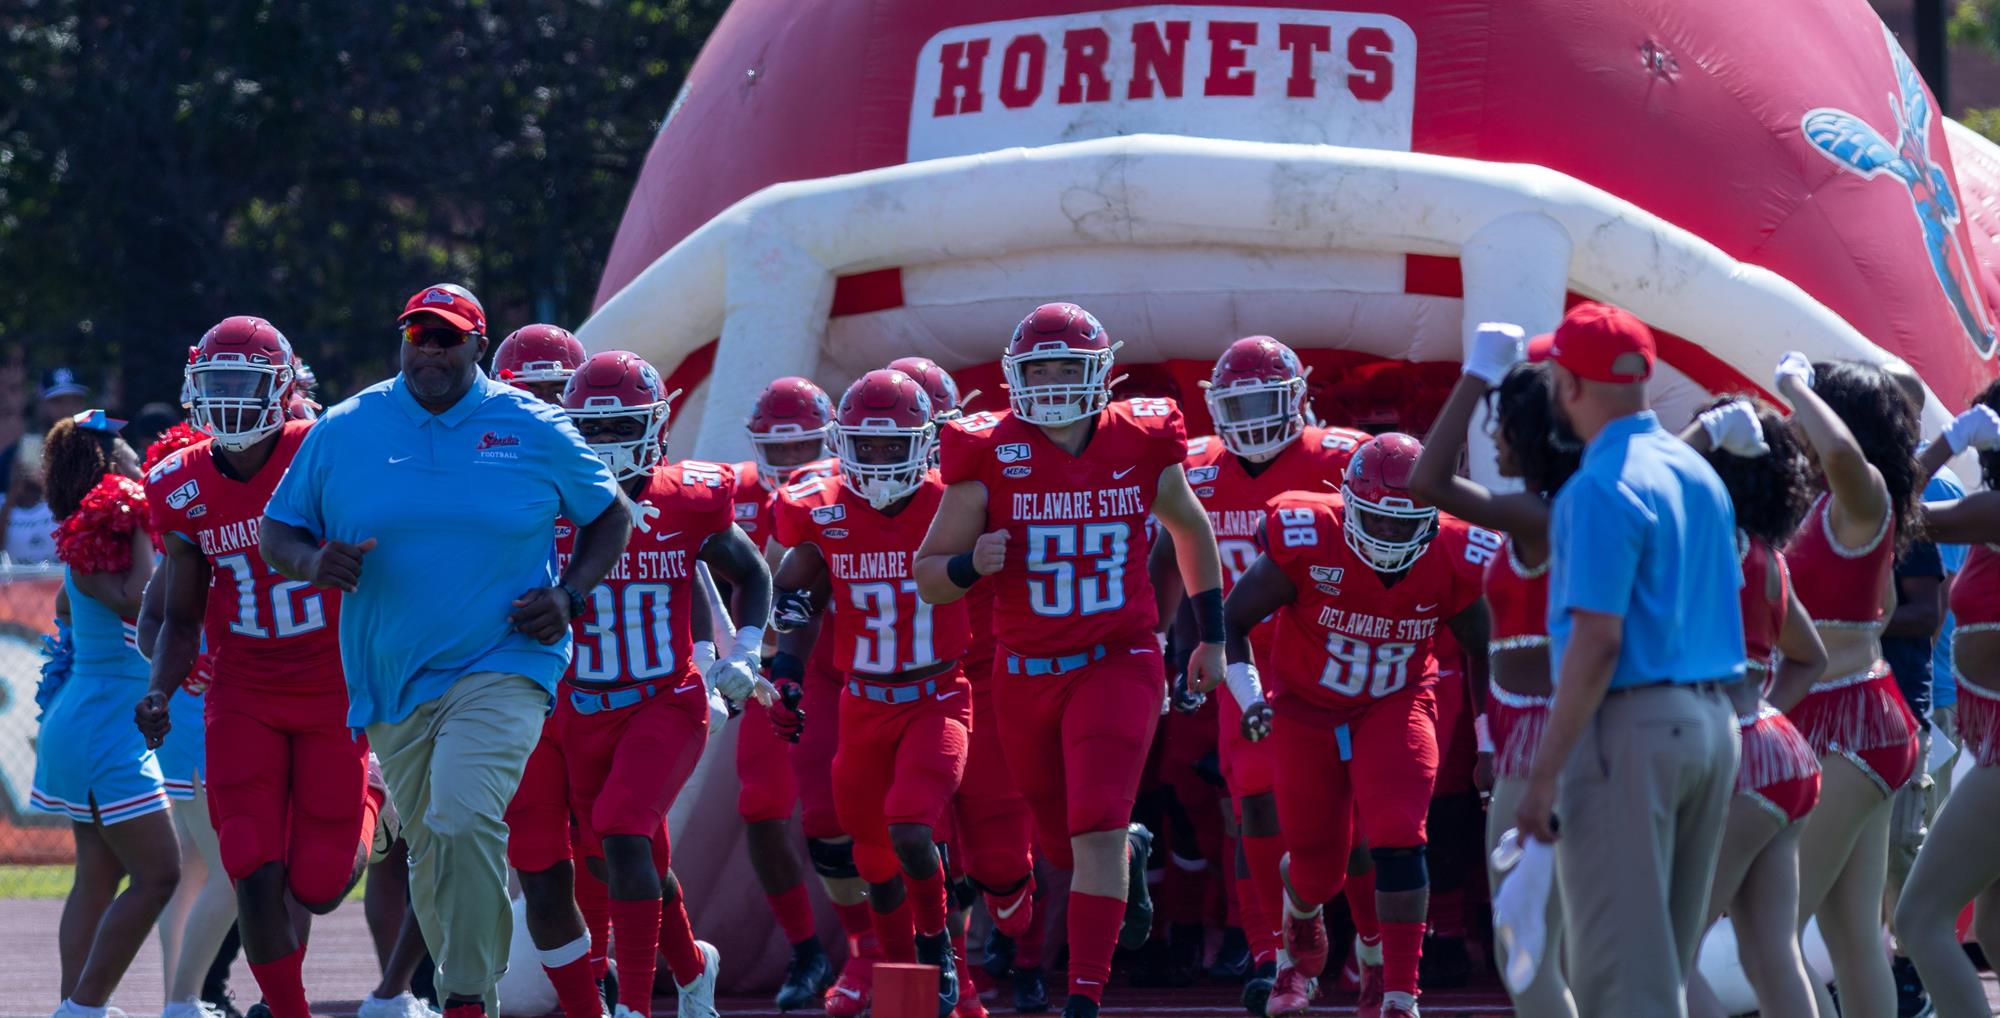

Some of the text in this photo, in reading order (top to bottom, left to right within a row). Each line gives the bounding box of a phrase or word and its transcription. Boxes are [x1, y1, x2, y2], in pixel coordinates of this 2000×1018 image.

[932, 20, 1394, 118] HORNETS
[480, 451, 520, 460] FOOTBALL
[996, 443, 1031, 464] 150
[1002, 466, 1032, 478] MEAC
[1187, 465, 1220, 485] 150
[166, 479, 200, 509] 150
[1012, 485, 1145, 521] DELAWARE STATE
[809, 503, 846, 525] 150
[1279, 507, 1319, 548] 98
[822, 528, 849, 539] MEAC
[1464, 525, 1502, 568] 98
[638, 550, 687, 579] STATE
[832, 551, 908, 579] DELAWARE
[1026, 521, 1130, 617] 53
[1309, 565, 1345, 584] 150
[215, 552, 327, 638] 12
[575, 582, 675, 682] 30
[848, 579, 942, 674] 31
[1317, 605, 1439, 641] DELAWARE STATE
[1318, 632, 1417, 699] 98
